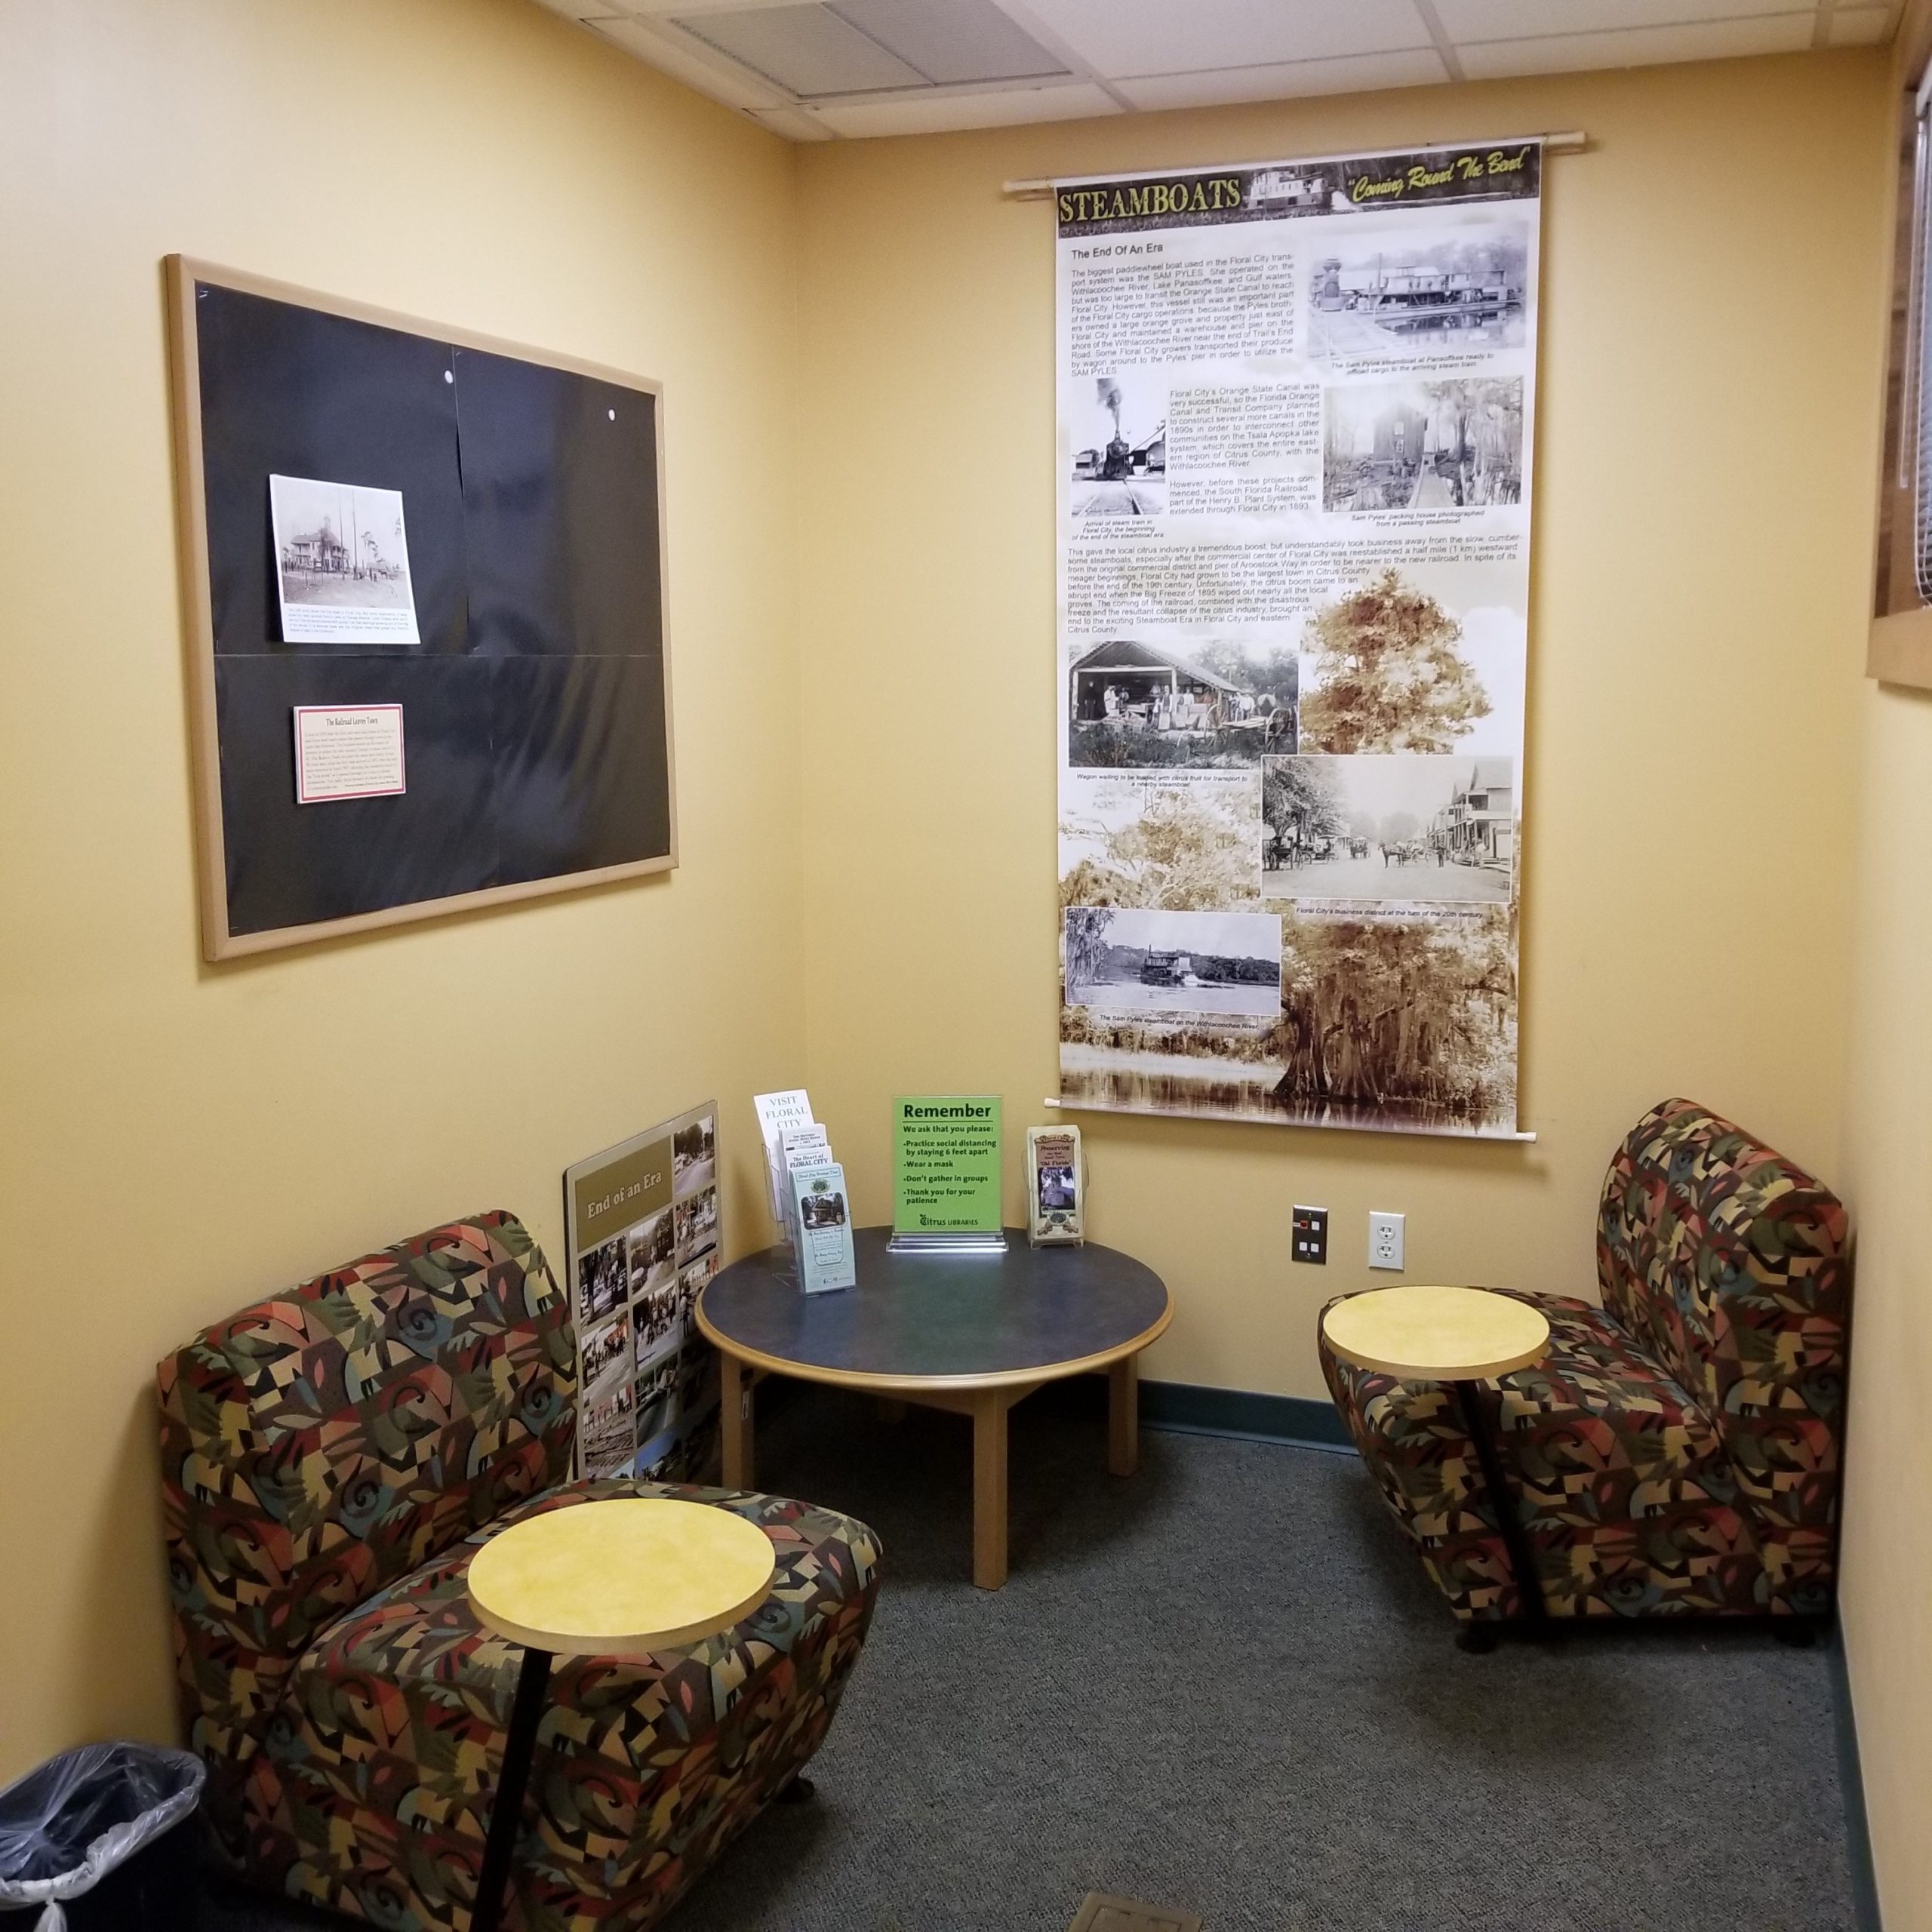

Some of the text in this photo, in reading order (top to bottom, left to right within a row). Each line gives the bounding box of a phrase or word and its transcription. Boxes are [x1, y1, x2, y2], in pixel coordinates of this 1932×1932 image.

[1407, 163, 1455, 190] Round
[1457, 156, 1484, 180] The
[1060, 179, 1241, 222] STEAMBOATS
[1072, 243, 1164, 259] The End Of An Era
[1072, 269, 1086, 278] The
[1088, 268, 1114, 278] biggest
[1116, 263, 1164, 275] paddlewheel
[1184, 260, 1204, 269] used
[1230, 257, 1252, 265] Floral
[1254, 256, 1269, 265] City
[1115, 294, 1134, 303] large
[1145, 291, 1168, 299] transit
[1183, 288, 1213, 297] Orange
[1214, 285, 1236, 294] State
[1237, 284, 1260, 292] Canal
[1272, 281, 1294, 289] reach
[1095, 331, 1109, 340] City
[1131, 327, 1172, 337] maintained
[1184, 323, 1227, 333] warehouse
[1248, 321, 1263, 330] pier
[1171, 389, 1192, 398] Floral
[1219, 386, 1250, 396] Orange
[1252, 385, 1273, 393] State
[1215, 405, 1241, 414] Transit
[1244, 403, 1283, 413] Company
[1287, 401, 1320, 411] planned
[1179, 416, 1214, 424] construct
[1216, 414, 1246, 423] several
[1169, 426, 1194, 434] 1890s
[1244, 421, 1294, 430] interconnect
[1068, 592, 1091, 600] abrupt
[1218, 588, 1241, 596] wiped
[1257, 587, 1281, 595] nearly
[770, 1096, 797, 1106] VISIT
[766, 1107, 808, 1118] FLORAL
[904, 1103, 991, 1117] Remember
[777, 1119, 801, 1128] CITY
[967, 1125, 994, 1134] please:
[959, 1140, 996, 1148] distancing
[906, 1149, 915, 1157] by
[917, 1149, 944, 1157] staying
[928, 1175, 952, 1183] gather
[588, 1172, 661, 1219] End of an Era
[906, 1197, 937, 1205] patience
[920, 1216, 946, 1225] Citrus
